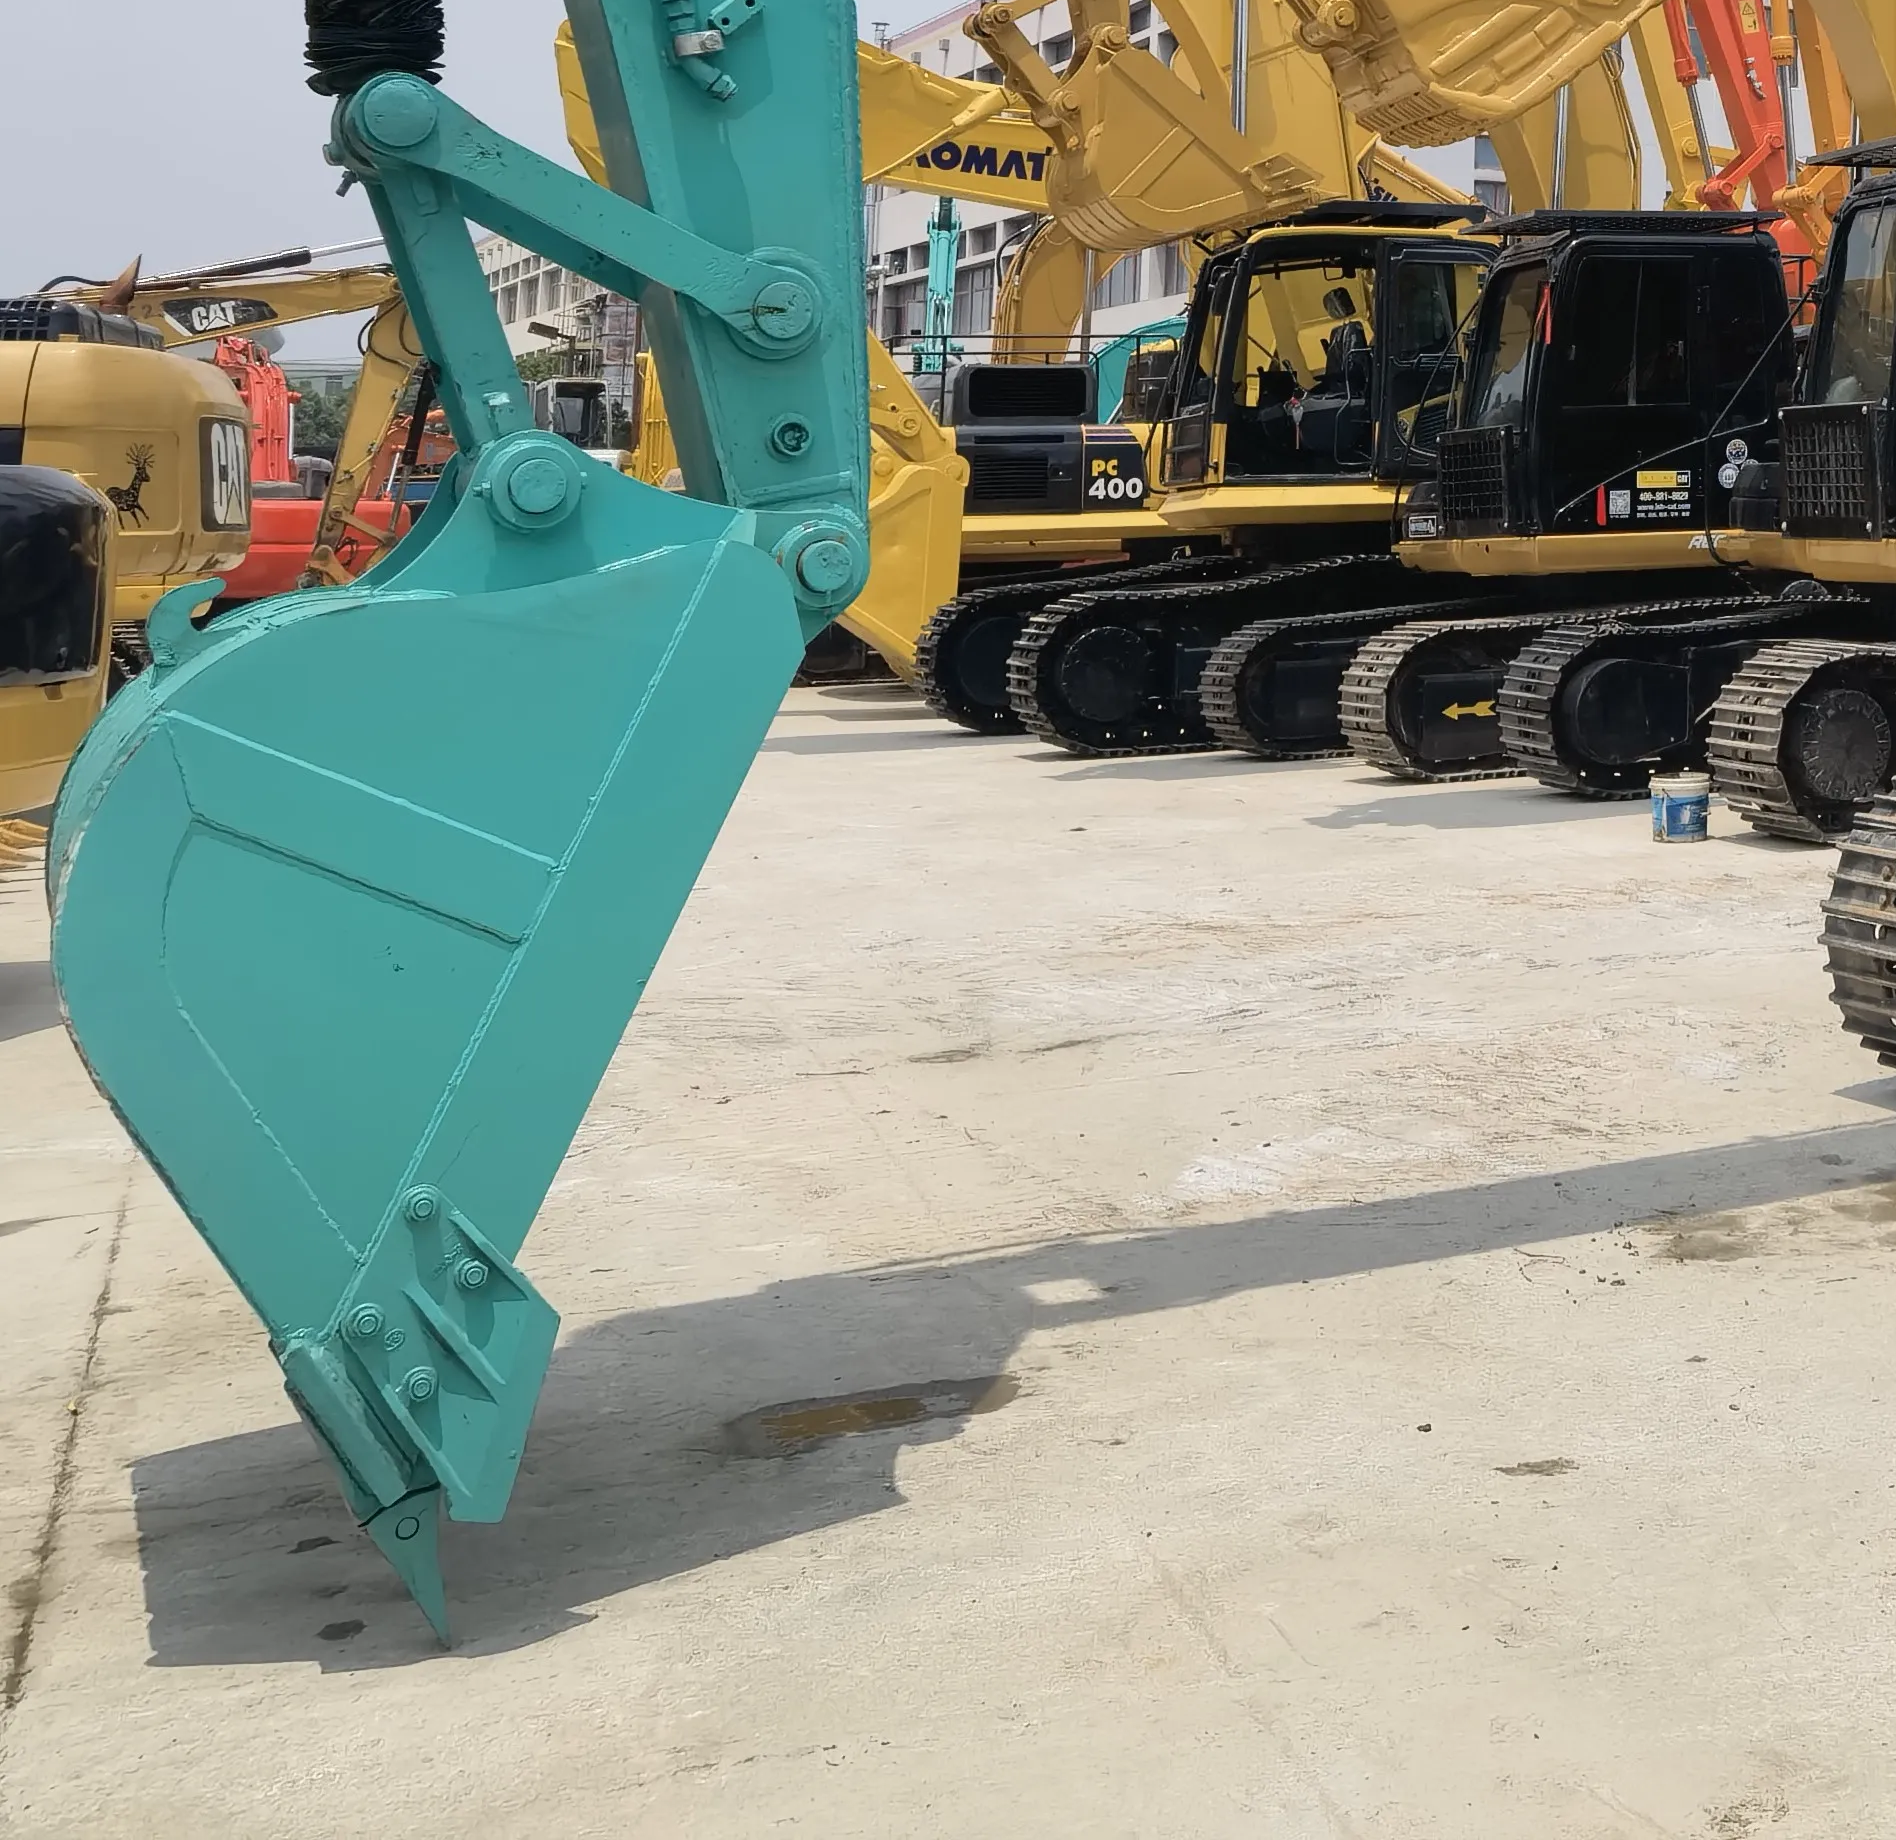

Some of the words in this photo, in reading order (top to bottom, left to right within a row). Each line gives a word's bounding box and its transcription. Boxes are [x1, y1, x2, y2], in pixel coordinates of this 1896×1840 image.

[192, 300, 237, 331] CAT
[211, 423, 248, 525] CAT
[1092, 460, 1118, 476] PC
[1088, 477, 1144, 500] 400
